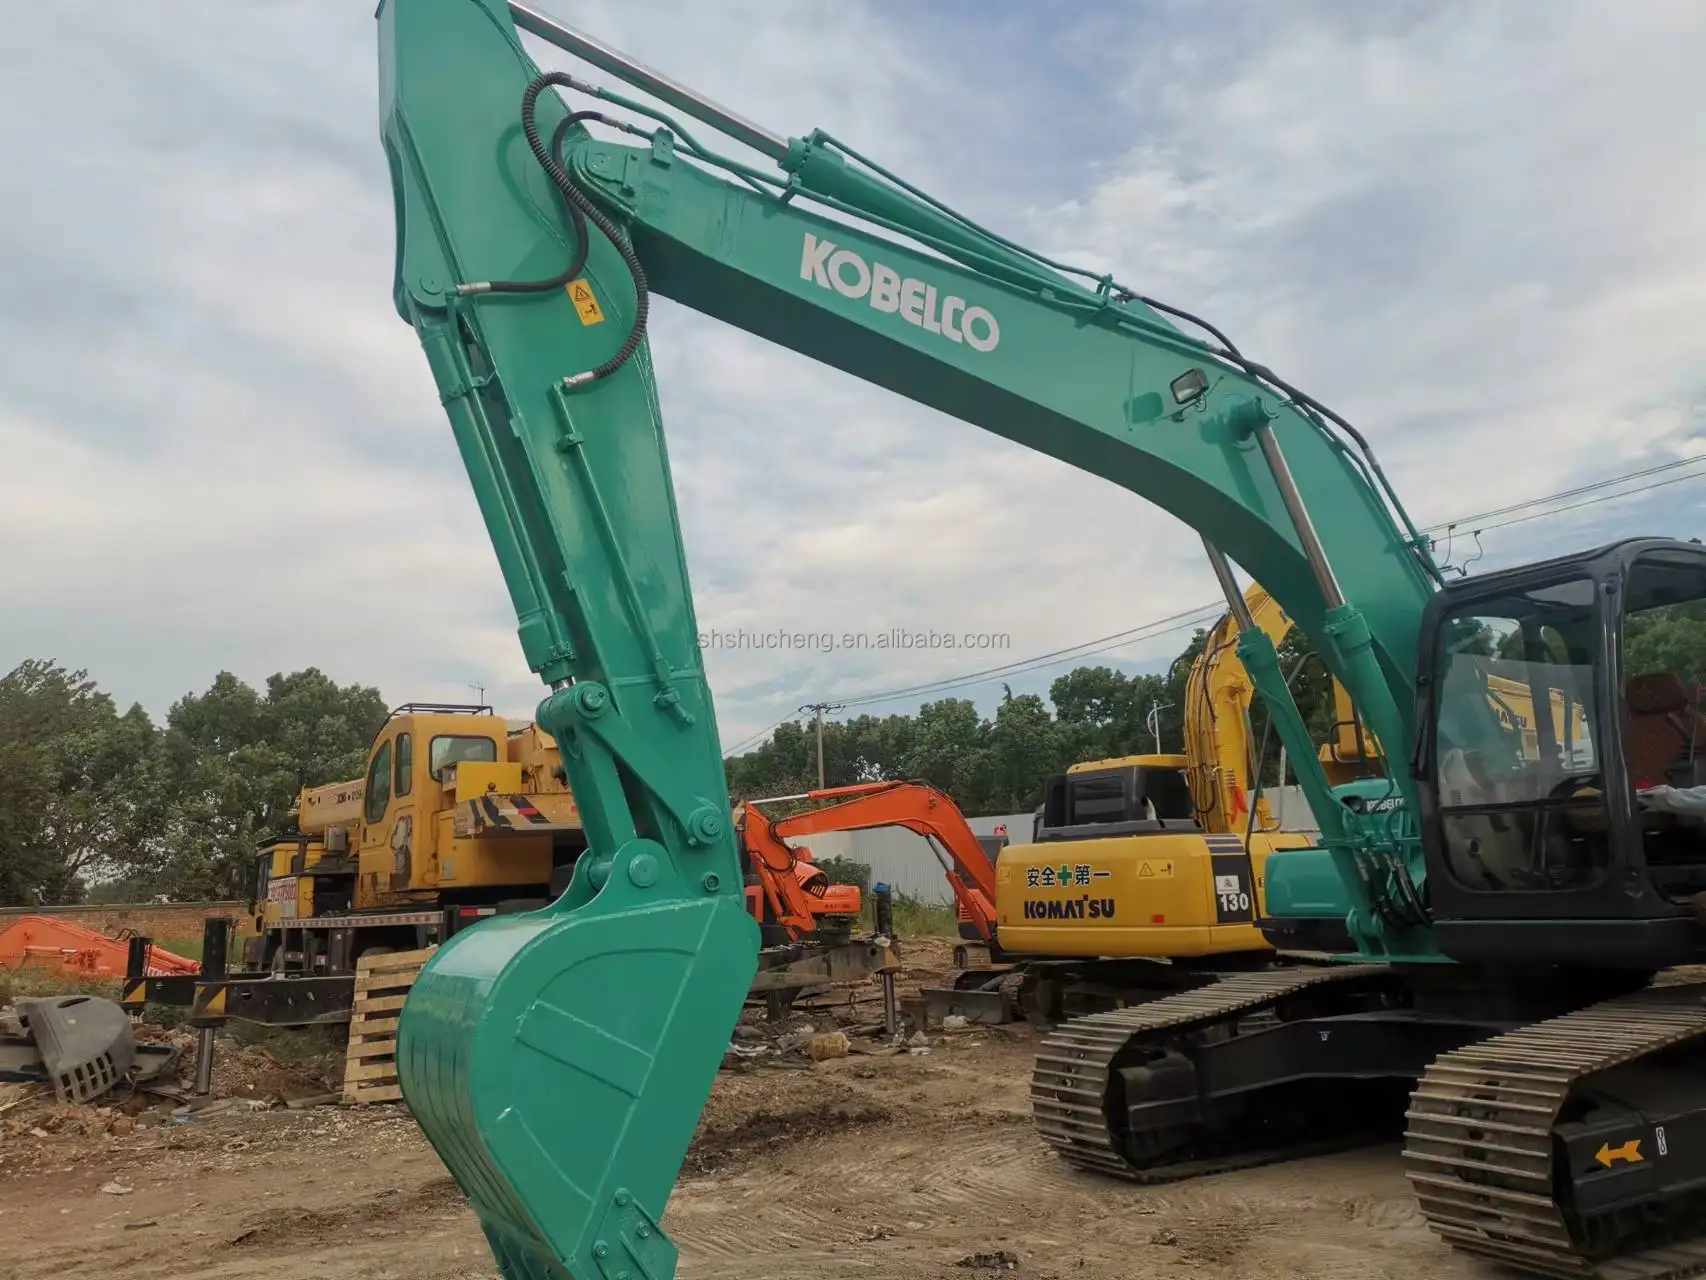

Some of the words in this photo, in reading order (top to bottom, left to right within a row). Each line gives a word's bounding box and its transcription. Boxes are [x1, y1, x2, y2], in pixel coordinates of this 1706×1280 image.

[800, 232, 999, 352] KOBELCO
[1024, 894, 1115, 919] KOMATSU
[1220, 893, 1249, 911] 130
